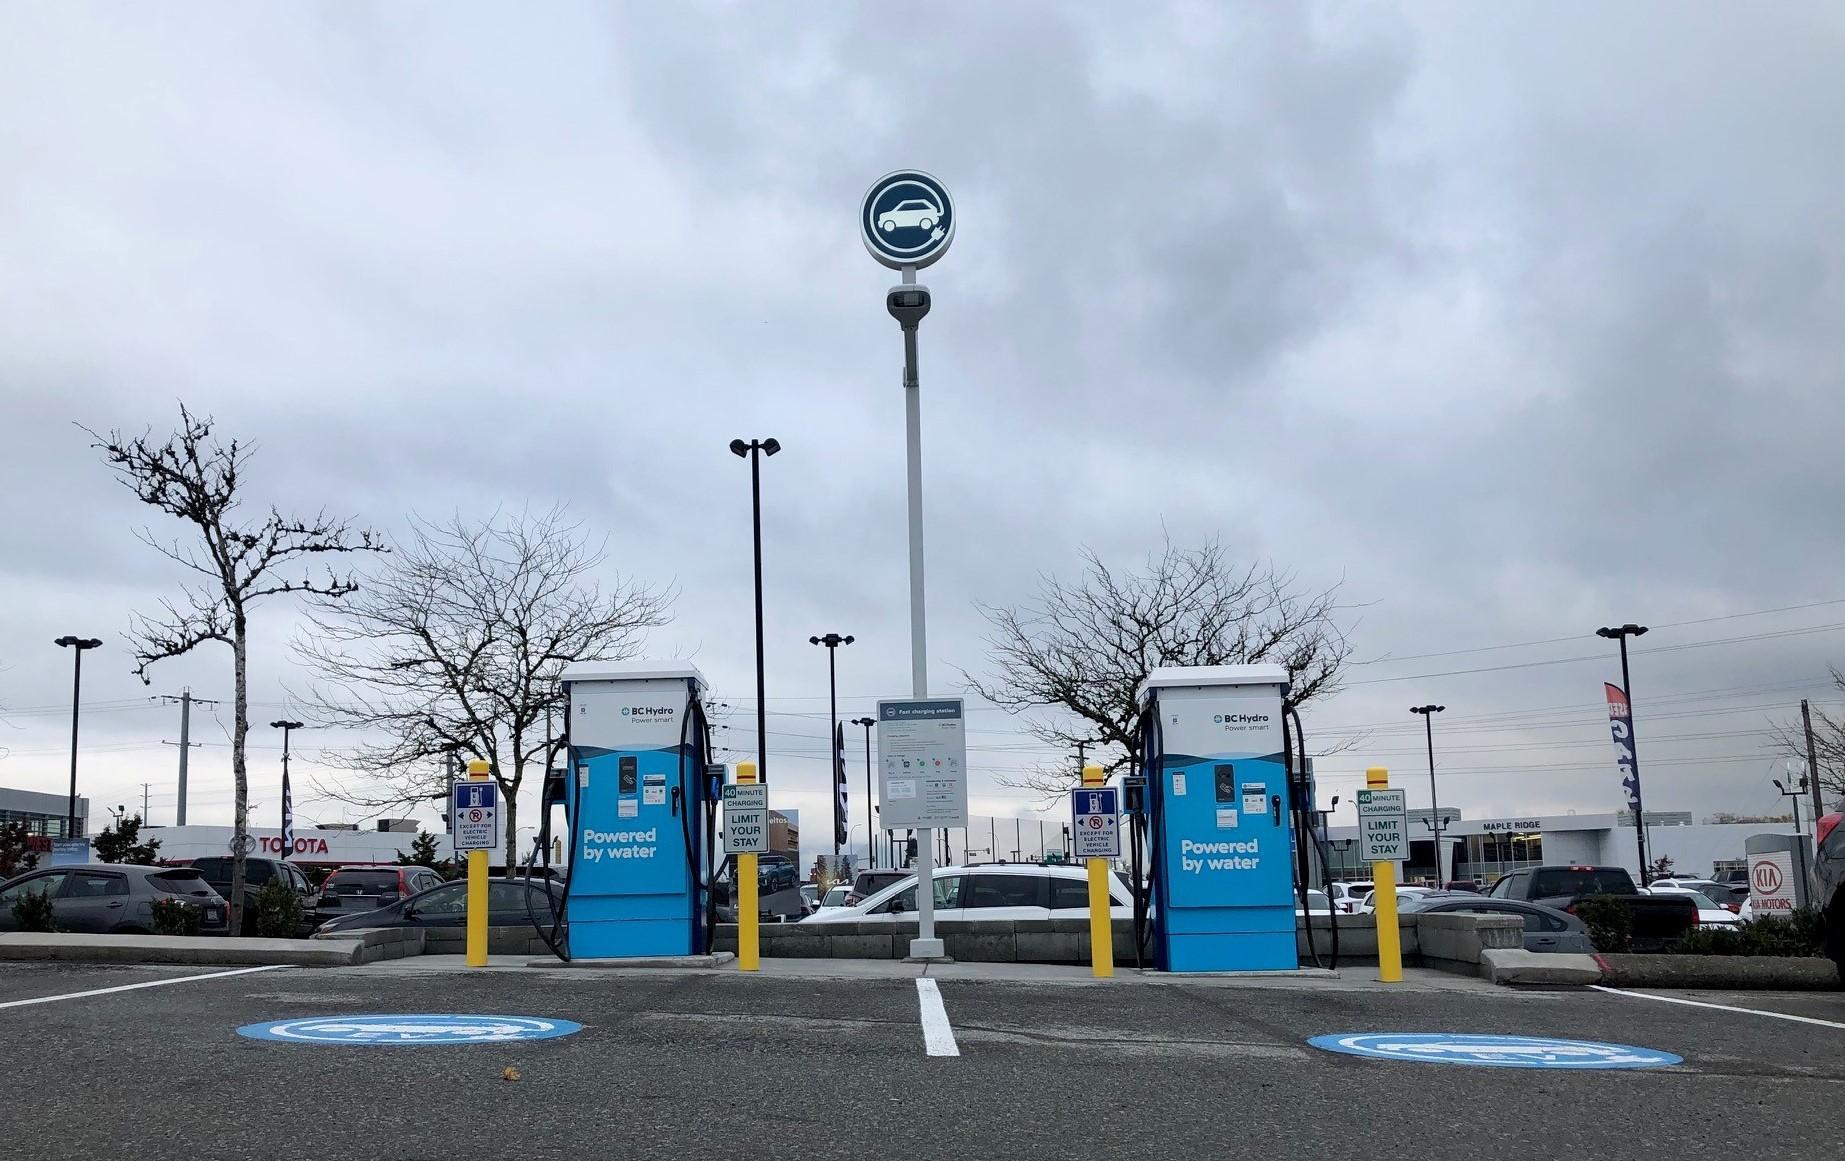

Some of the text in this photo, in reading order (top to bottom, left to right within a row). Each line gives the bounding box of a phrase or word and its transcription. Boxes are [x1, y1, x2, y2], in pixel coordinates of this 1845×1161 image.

[632, 707, 674, 716] BC Hydro
[1239, 714, 1269, 724] Hydro
[724, 788, 736, 797] 40
[731, 814, 760, 824] LIMIT
[731, 826, 761, 835] YOUR
[1368, 821, 1398, 830] LIMIT
[583, 827, 656, 844] Powered
[1368, 833, 1400, 842] YOUR
[260, 837, 328, 854] TOOTA
[733, 838, 758, 847] STAY
[1181, 838, 1259, 854] Powered
[583, 845, 656, 863] by water
[1371, 844, 1398, 854] STAY
[1182, 856, 1260, 874] by water
[1756, 869, 1777, 887] KIA
[1761, 898, 1792, 909] MOTORS
